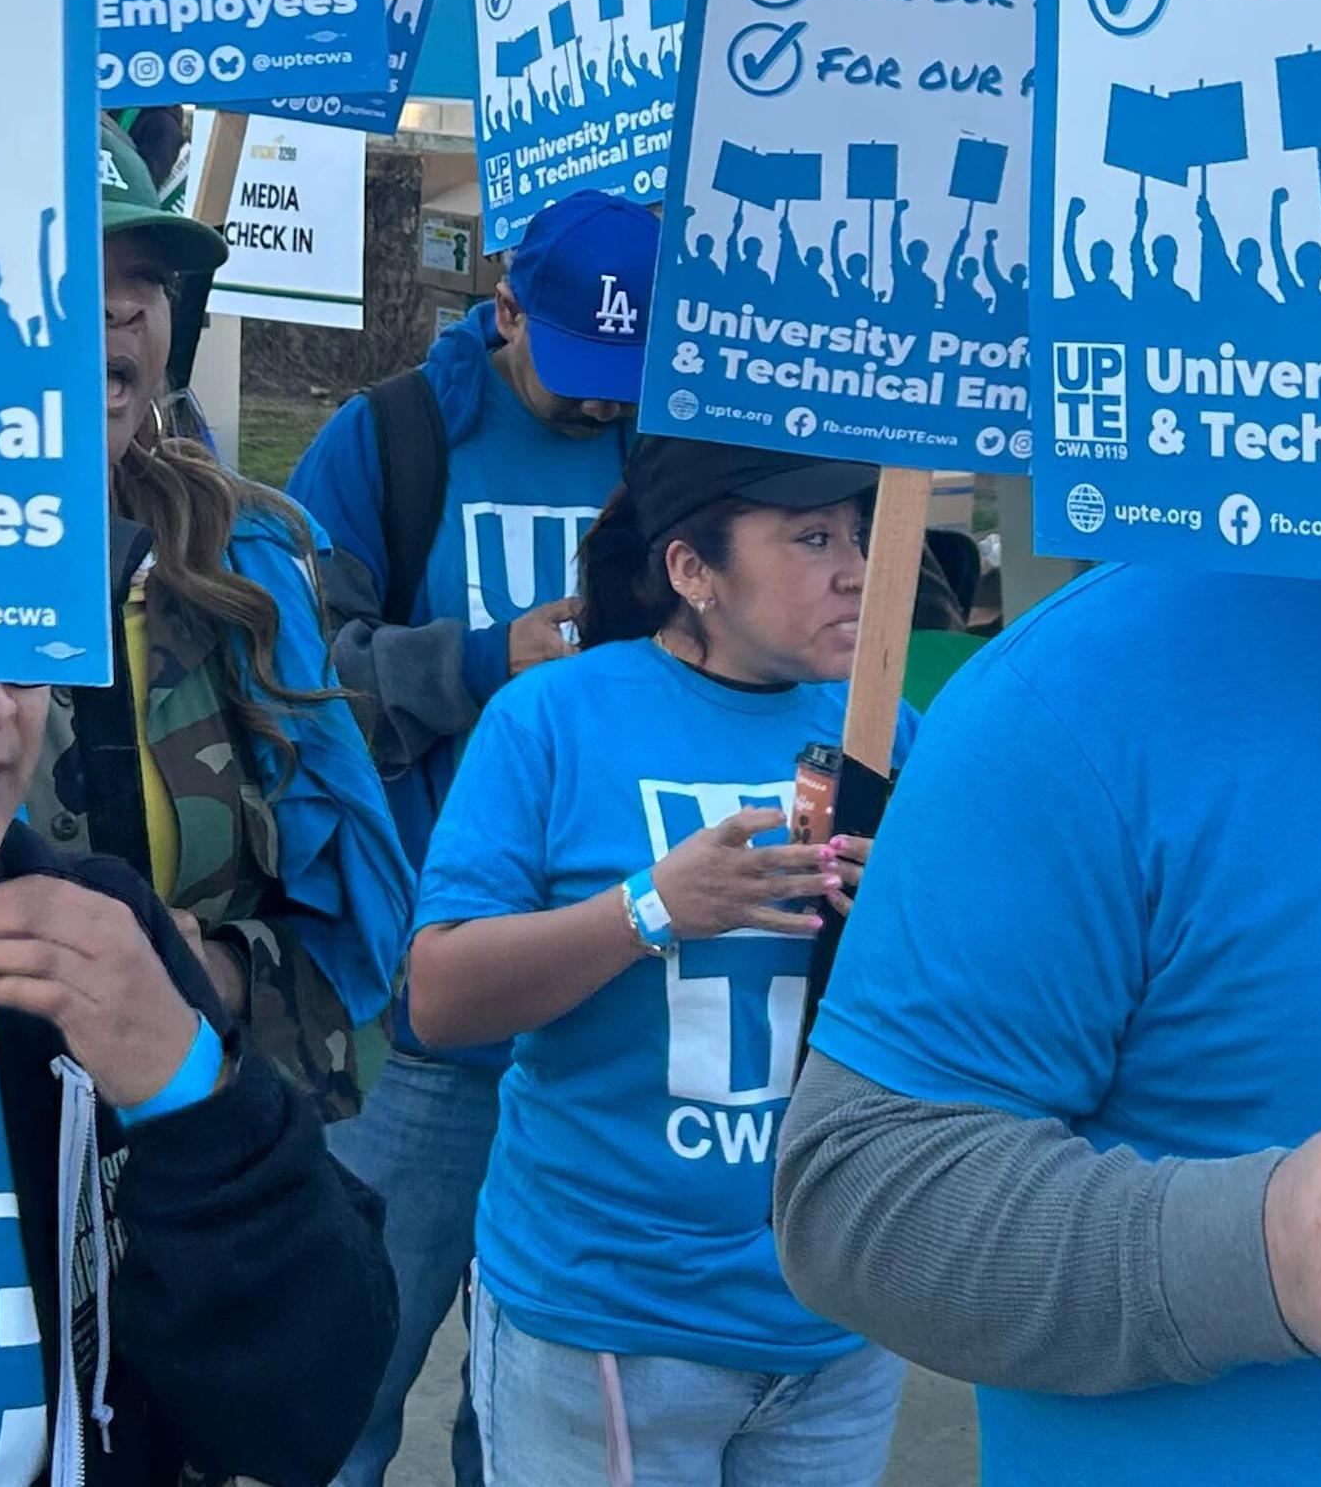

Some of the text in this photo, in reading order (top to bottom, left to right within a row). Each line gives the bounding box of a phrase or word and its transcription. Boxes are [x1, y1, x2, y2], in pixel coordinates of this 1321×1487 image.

[252, 51, 352, 72] @uptecwa
[817, 47, 901, 89] FOR
[918, 60, 1002, 96] OUR
[516, 120, 610, 169] University
[518, 143, 628, 195] & Technical
[240, 182, 300, 211] MEDIA
[225, 221, 313, 253] CHECK IN
[596, 274, 637, 335] LA
[677, 298, 917, 366] University
[672, 342, 704, 375] &
[719, 348, 944, 406] Technical
[1058, 345, 1123, 391] UP
[704, 403, 958, 447] upte.org fb.com/UPTEcwa
[1056, 394, 1123, 440] TE
[1148, 412, 1185, 456] &
[1055, 442, 1129, 460] CWA 9119
[1114, 499, 1203, 531] upte.org
[667, 1106, 774, 1164] CW
